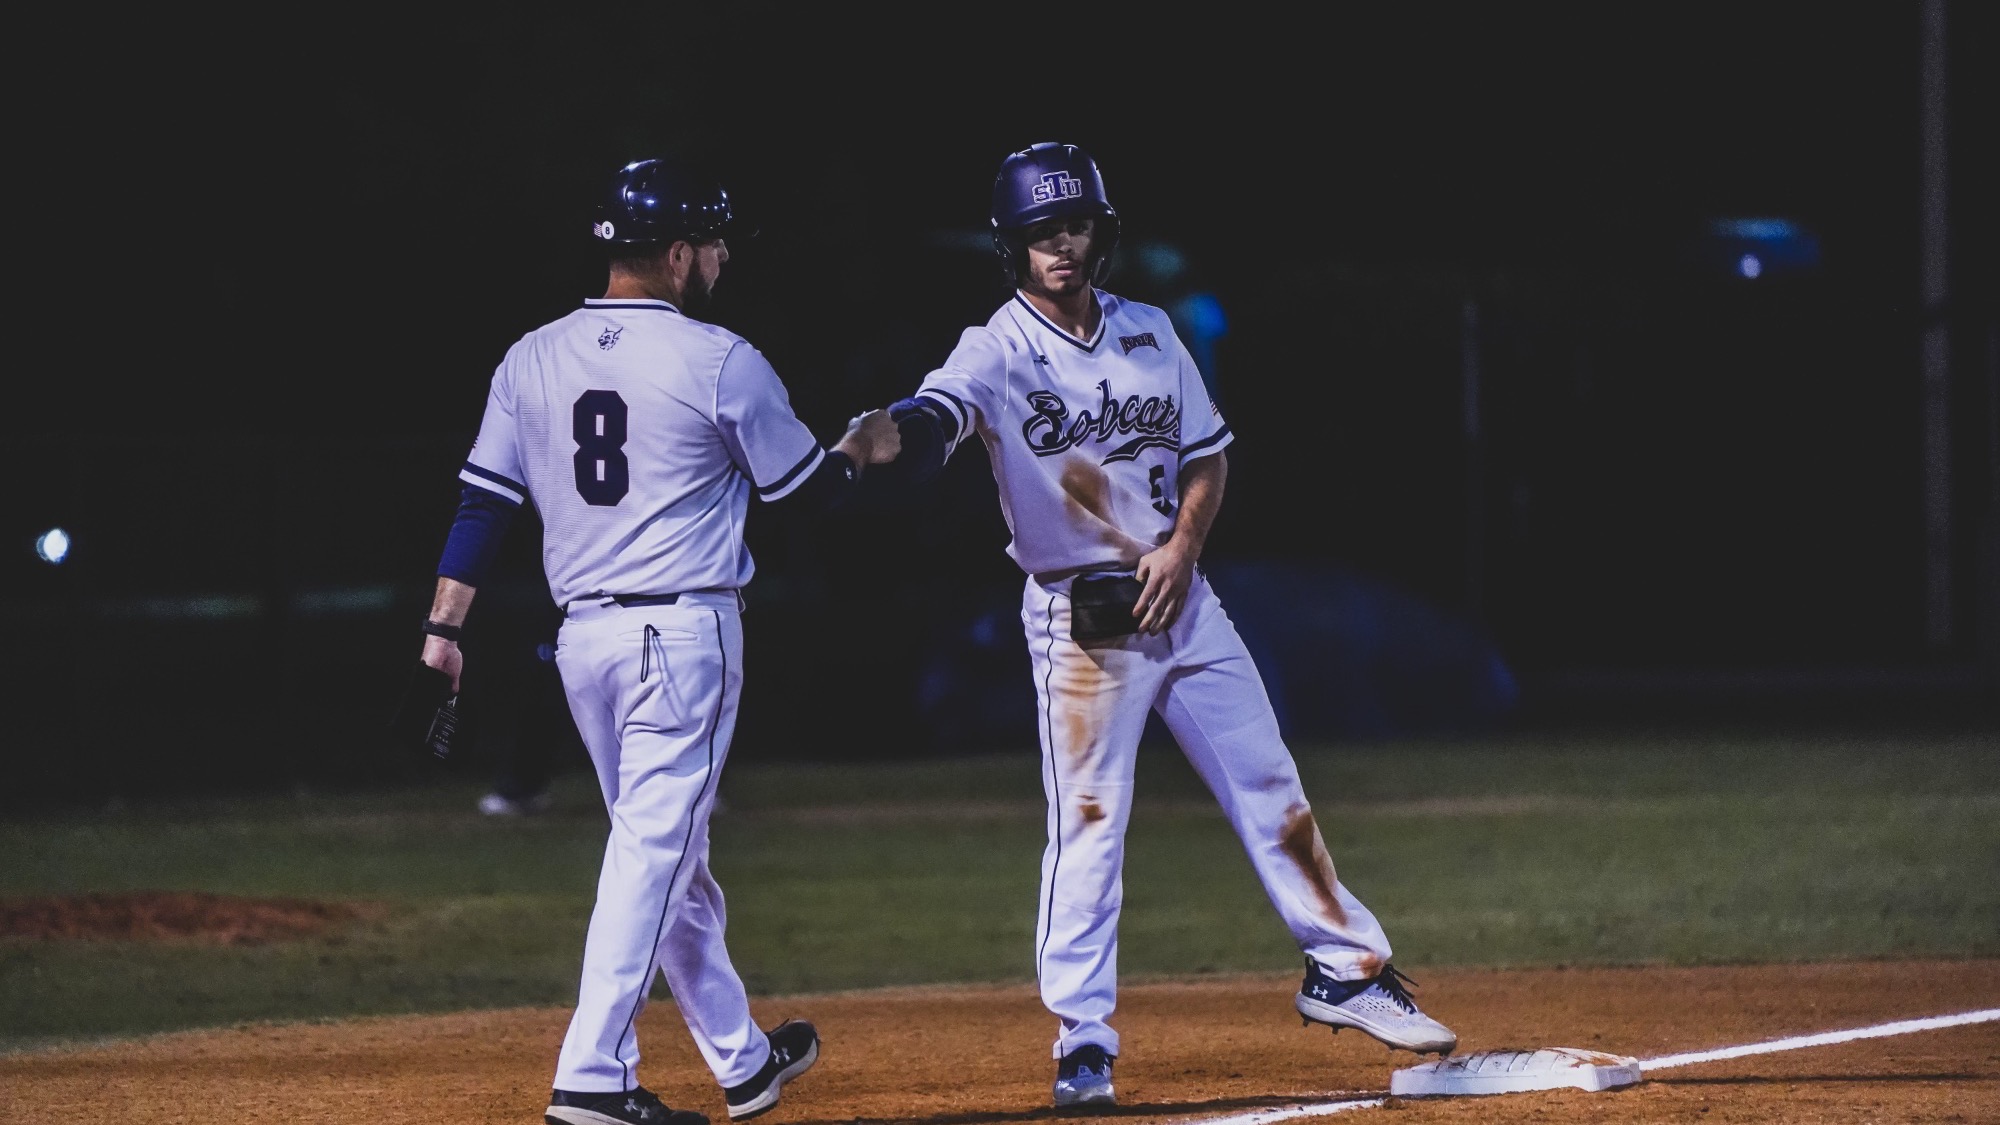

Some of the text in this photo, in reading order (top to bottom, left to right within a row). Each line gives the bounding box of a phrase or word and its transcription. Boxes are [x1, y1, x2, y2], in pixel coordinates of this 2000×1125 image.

[1032, 170, 1082, 204] STU
[605, 226, 611, 235] 8
[572, 389, 629, 507] 8
